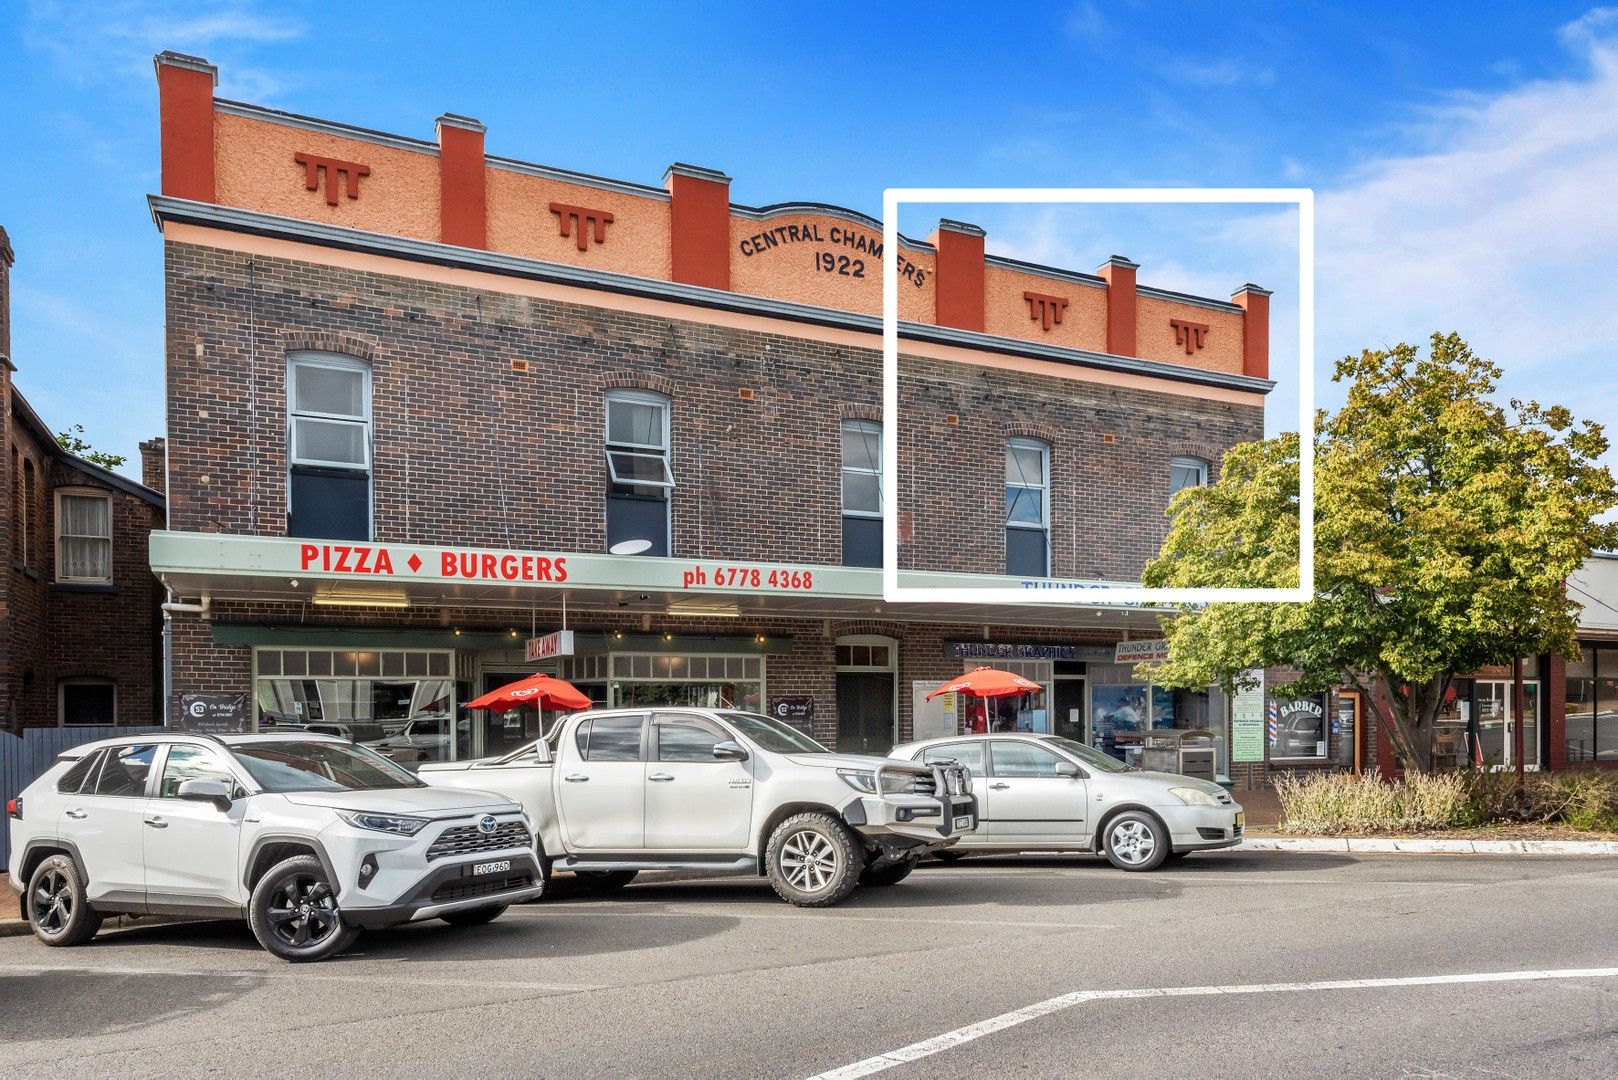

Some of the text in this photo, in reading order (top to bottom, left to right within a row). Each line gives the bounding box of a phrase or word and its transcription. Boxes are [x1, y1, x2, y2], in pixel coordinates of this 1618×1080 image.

[740, 224, 926, 288] CENTRAL CHAMERS
[815, 251, 865, 279] 1922
[301, 544, 568, 583] PIZZA BURGERS
[683, 565, 813, 590] ph 6778 4368
[1117, 652, 1154, 661] DEFENCE
[1118, 641, 1152, 654] THUNDER
[1280, 700, 1323, 718] BARBER
